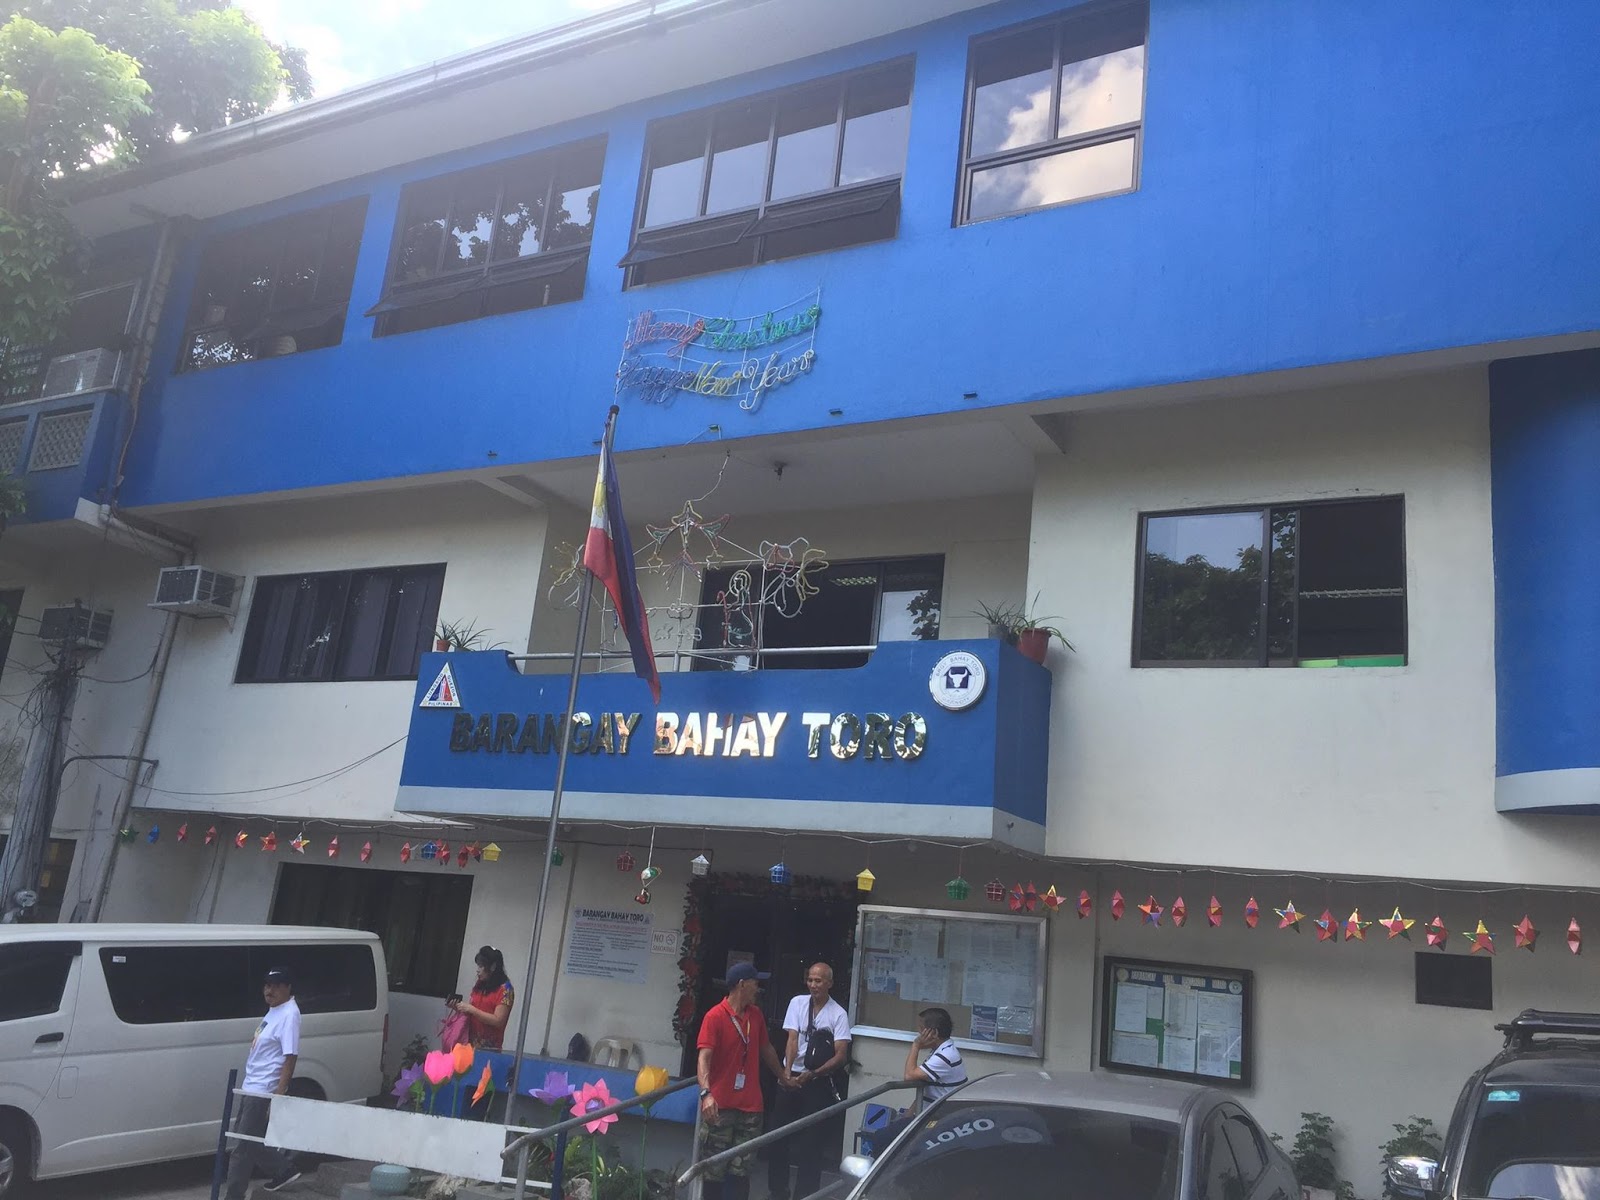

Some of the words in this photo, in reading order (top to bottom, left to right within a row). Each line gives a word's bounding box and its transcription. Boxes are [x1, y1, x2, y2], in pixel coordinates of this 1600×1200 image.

[624, 309, 705, 359] Merry
[683, 360, 743, 395] New
[450, 712, 640, 754] BARANGAY
[653, 711, 788, 758] BAHAY
[801, 711, 928, 759] TORO
[582, 909, 611, 919] BARANGAY
[610, 911, 630, 921] BAHAY
[629, 913, 644, 922] TORO
[652, 944, 675, 953] SMOKING
[653, 933, 664, 943] NO
